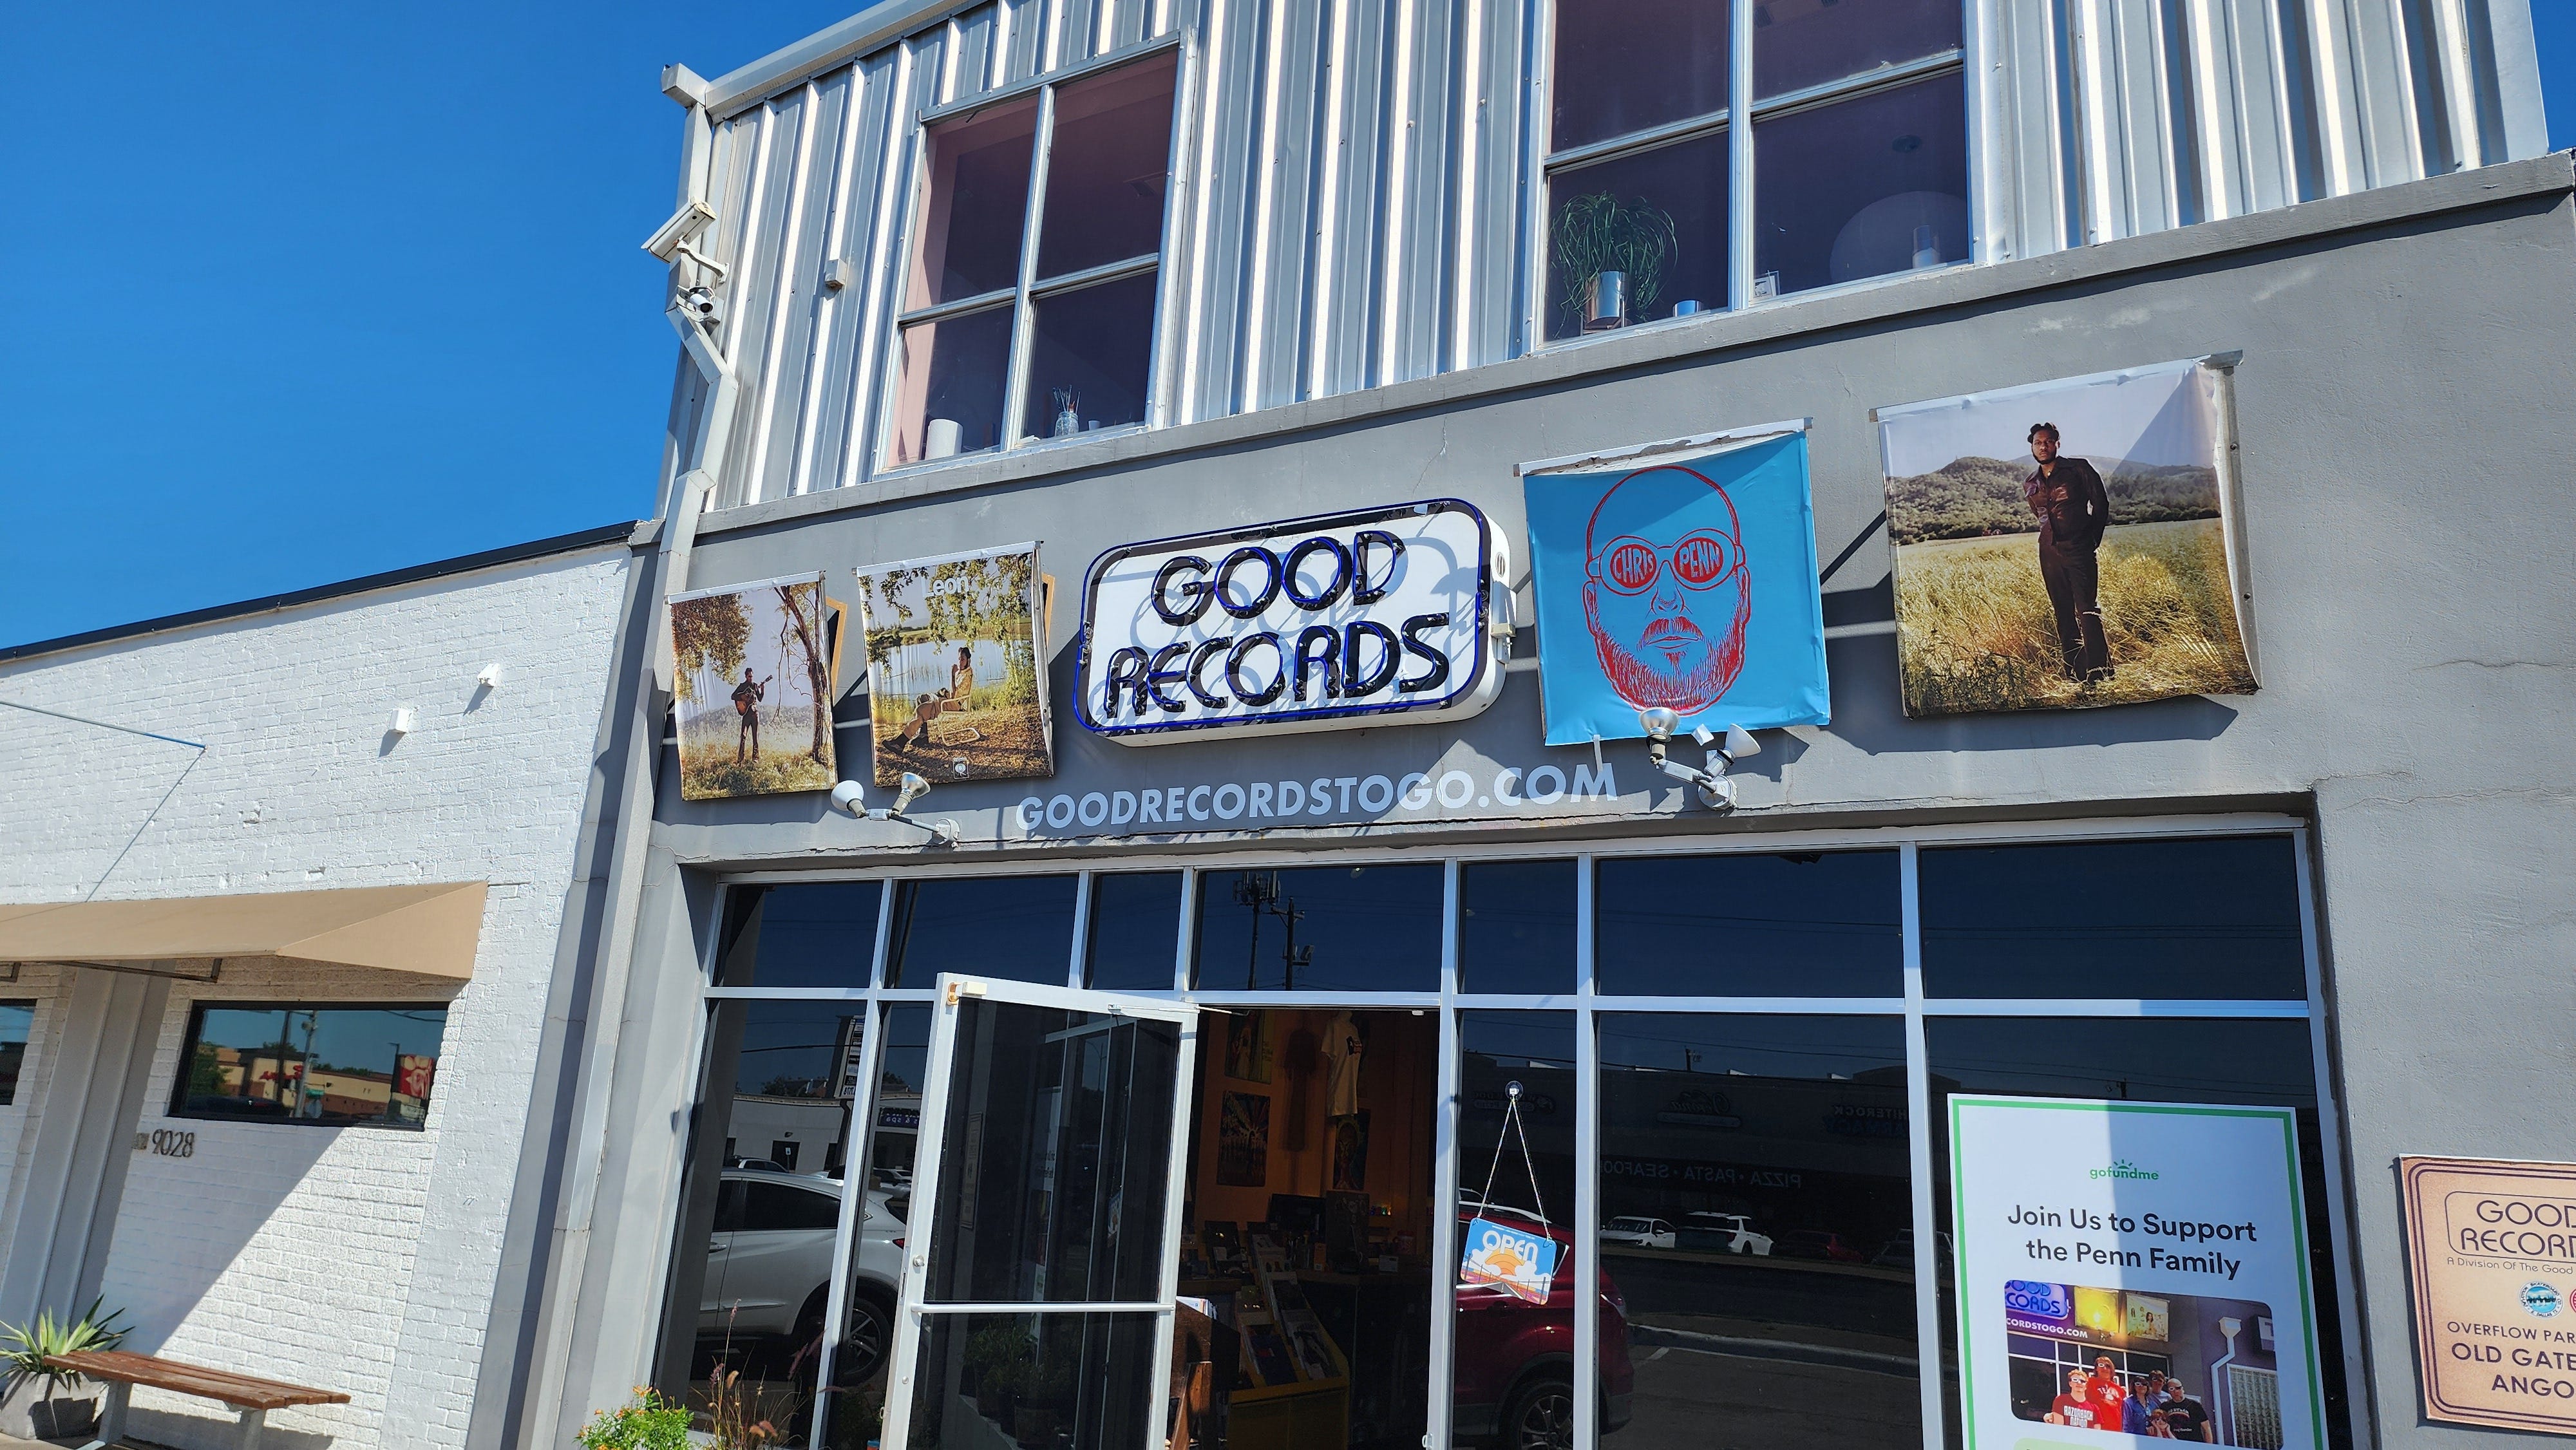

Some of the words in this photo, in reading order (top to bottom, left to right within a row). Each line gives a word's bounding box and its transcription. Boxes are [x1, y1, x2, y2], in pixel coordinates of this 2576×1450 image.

[1613, 551, 1656, 584] CHRIS
[1679, 540, 1721, 577] PENN
[921, 575, 969, 598] Leon
[1150, 530, 1405, 626] GOOD
[1104, 612, 1449, 719] RECORDS
[1016, 762, 1618, 831] GOODRECORDSTOGO.COM
[152, 1129, 194, 1158] 9028
[2090, 1165, 2159, 1180] gofundme
[2007, 1205, 2061, 1227] Join
[2070, 1209, 2101, 1230] Us
[2108, 1213, 2136, 1233] to
[2143, 1213, 2257, 1243] Support
[2026, 1239, 2068, 1261] the
[2076, 1242, 2141, 1268] Penn
[2150, 1247, 2241, 1281] Family
[2447, 1257, 2454, 1265] A
[2458, 1257, 2499, 1268] Division
[2503, 1261, 2516, 1270] Of
[2519, 1262, 2538, 1272] The
[2542, 1265, 2573, 1274] Good
[2447, 1321, 2537, 1341] OVERFLOW
[2451, 1342, 2502, 1363] OLD
[2491, 1374, 2575, 1399] ANGO
